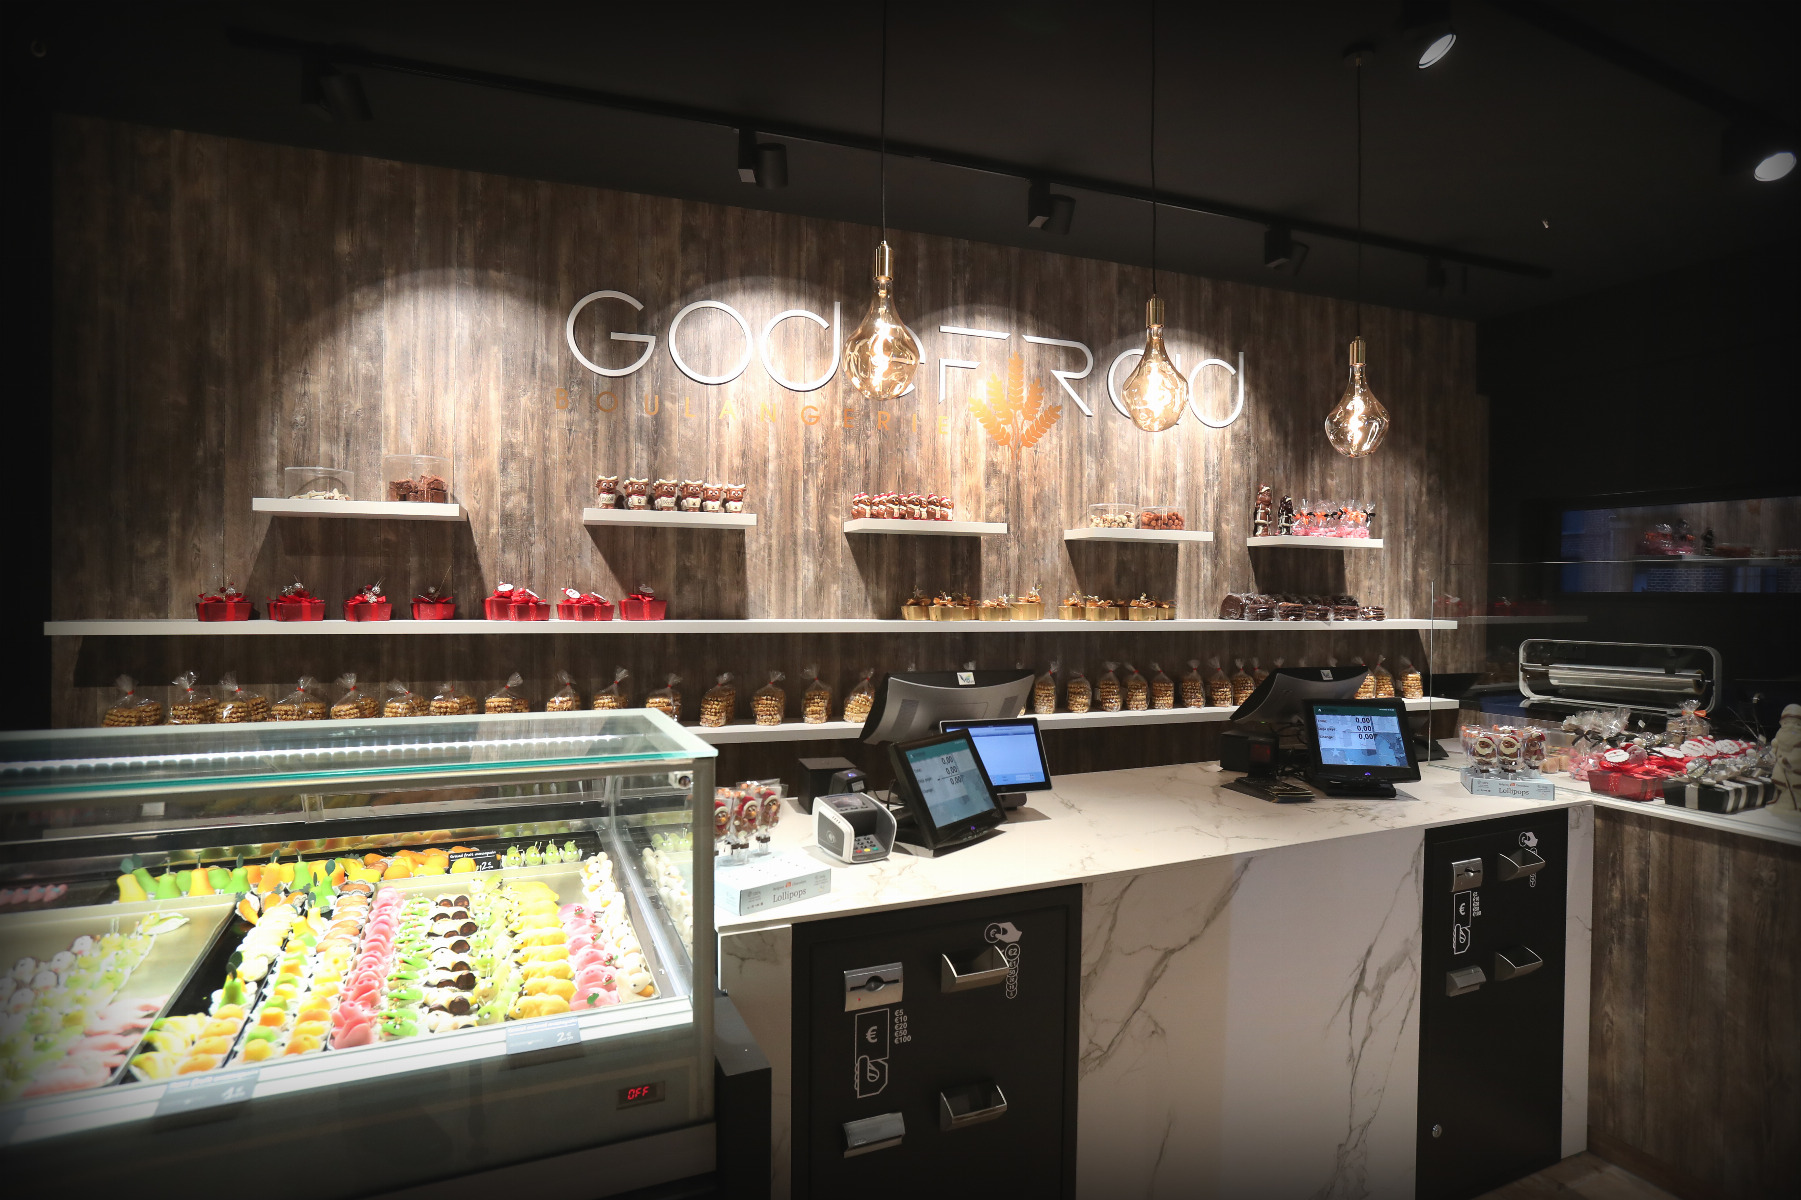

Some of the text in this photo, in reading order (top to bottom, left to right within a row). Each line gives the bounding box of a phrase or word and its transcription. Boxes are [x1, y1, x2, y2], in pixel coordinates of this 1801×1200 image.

[555, 387, 950, 435] BOULANGERIE
[1498, 787, 1530, 796] Lollipops
[772, 888, 807, 903] Lollipops
[1008, 948, 1018, 957] €2
[894, 1009, 904, 1017] €5
[894, 1015, 908, 1024] €10
[894, 1022, 908, 1031] €20
[865, 1025, 878, 1043] €
[894, 1035, 912, 1044] €100
[627, 1086, 650, 1100] OFF
